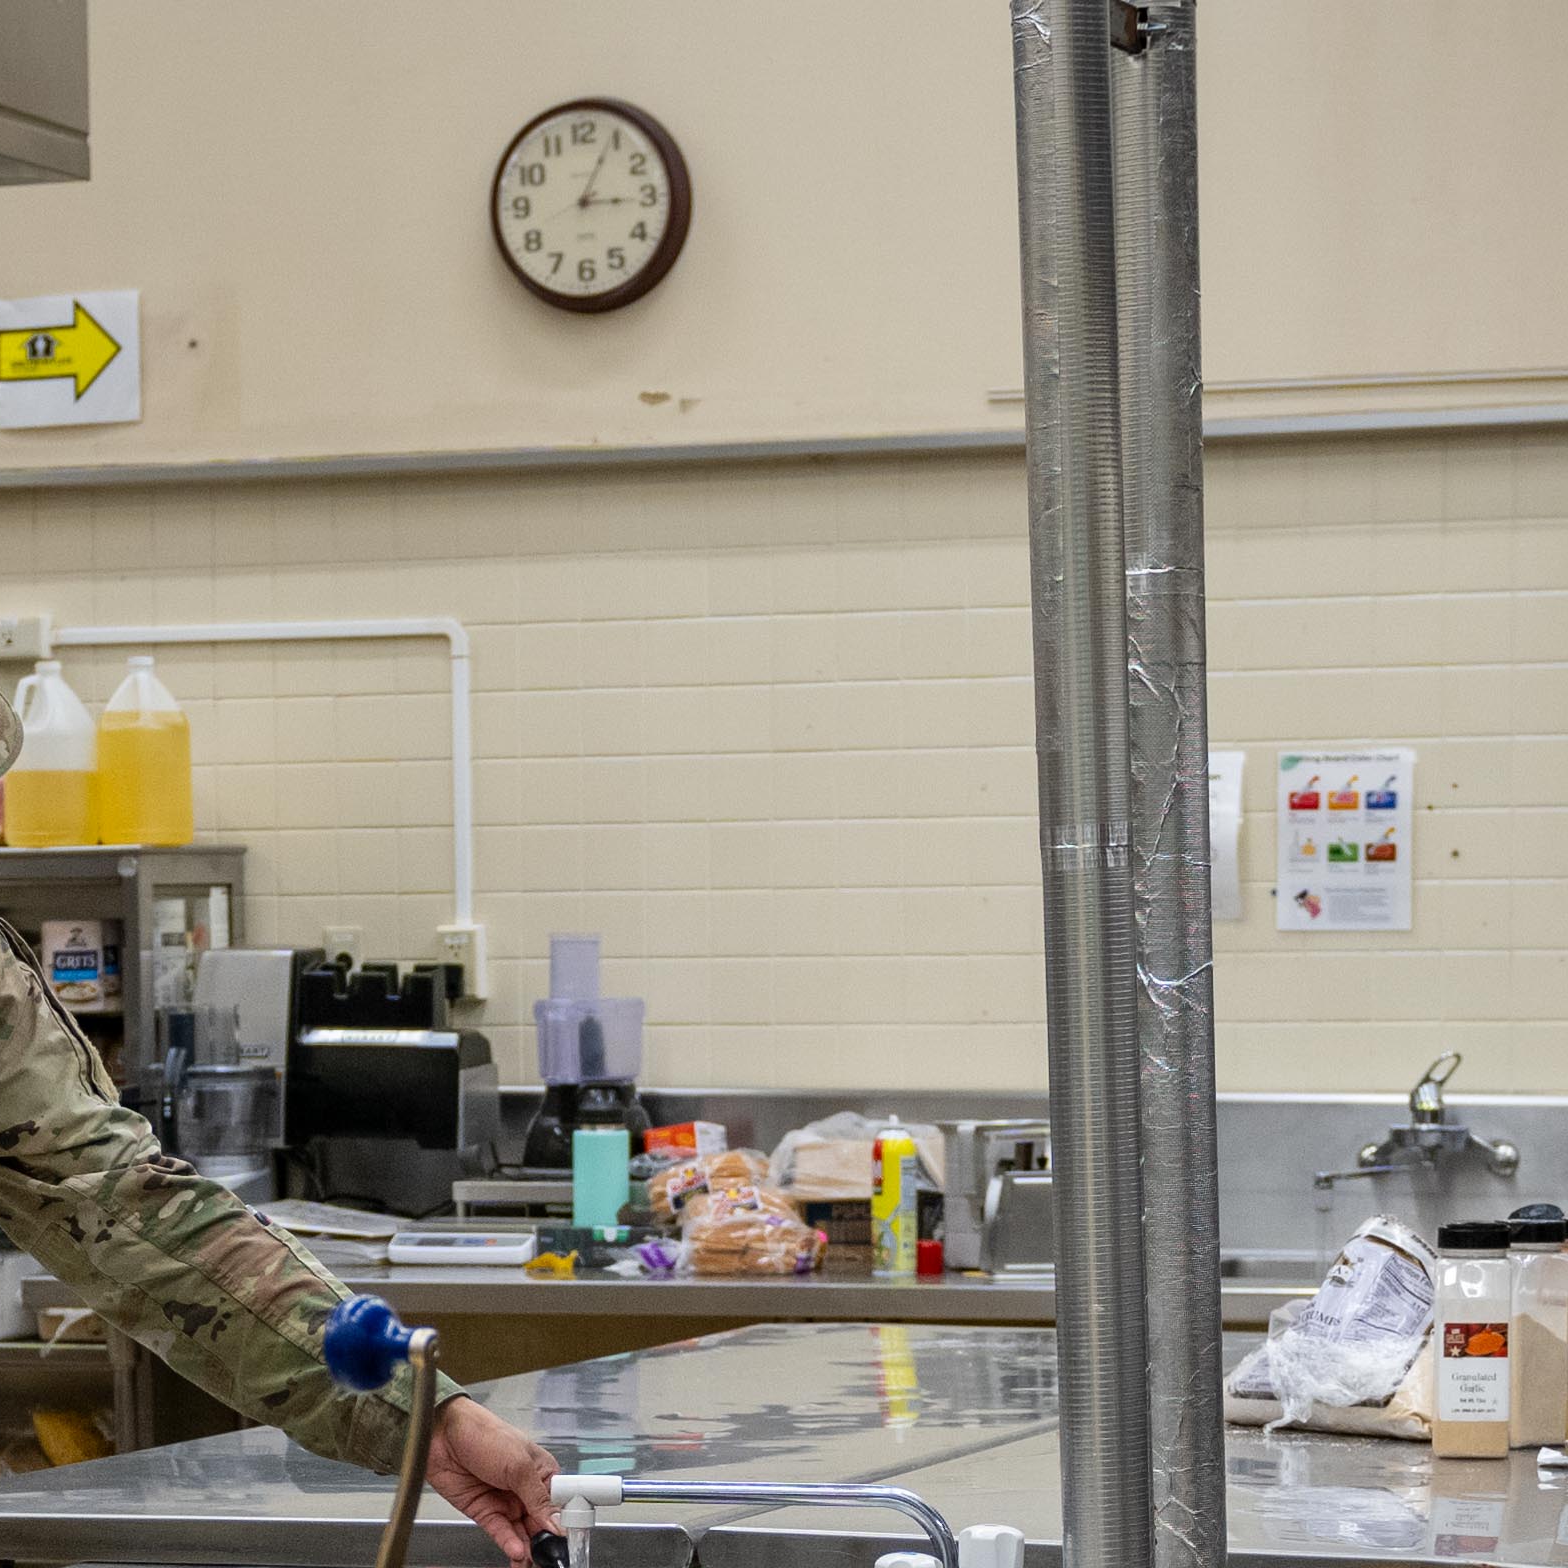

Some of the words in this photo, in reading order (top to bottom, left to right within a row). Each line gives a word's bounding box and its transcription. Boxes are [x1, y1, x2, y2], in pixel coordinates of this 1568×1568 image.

[571, 121, 596, 145] 12
[612, 129, 620, 150] 1
[544, 134, 561, 157] 11
[519, 163, 545, 186] 10
[629, 153, 645, 175] 2
[640, 184, 656, 207] 3
[512, 196, 530, 219] 9
[524, 229, 542, 252] 8
[630, 221, 647, 242] 4
[548, 252, 564, 274] 7
[608, 247, 625, 269] 5
[577, 258, 596, 281] 6
[56, 954, 96, 968] GRITS
[1451, 1372, 1497, 1381] Granulated
